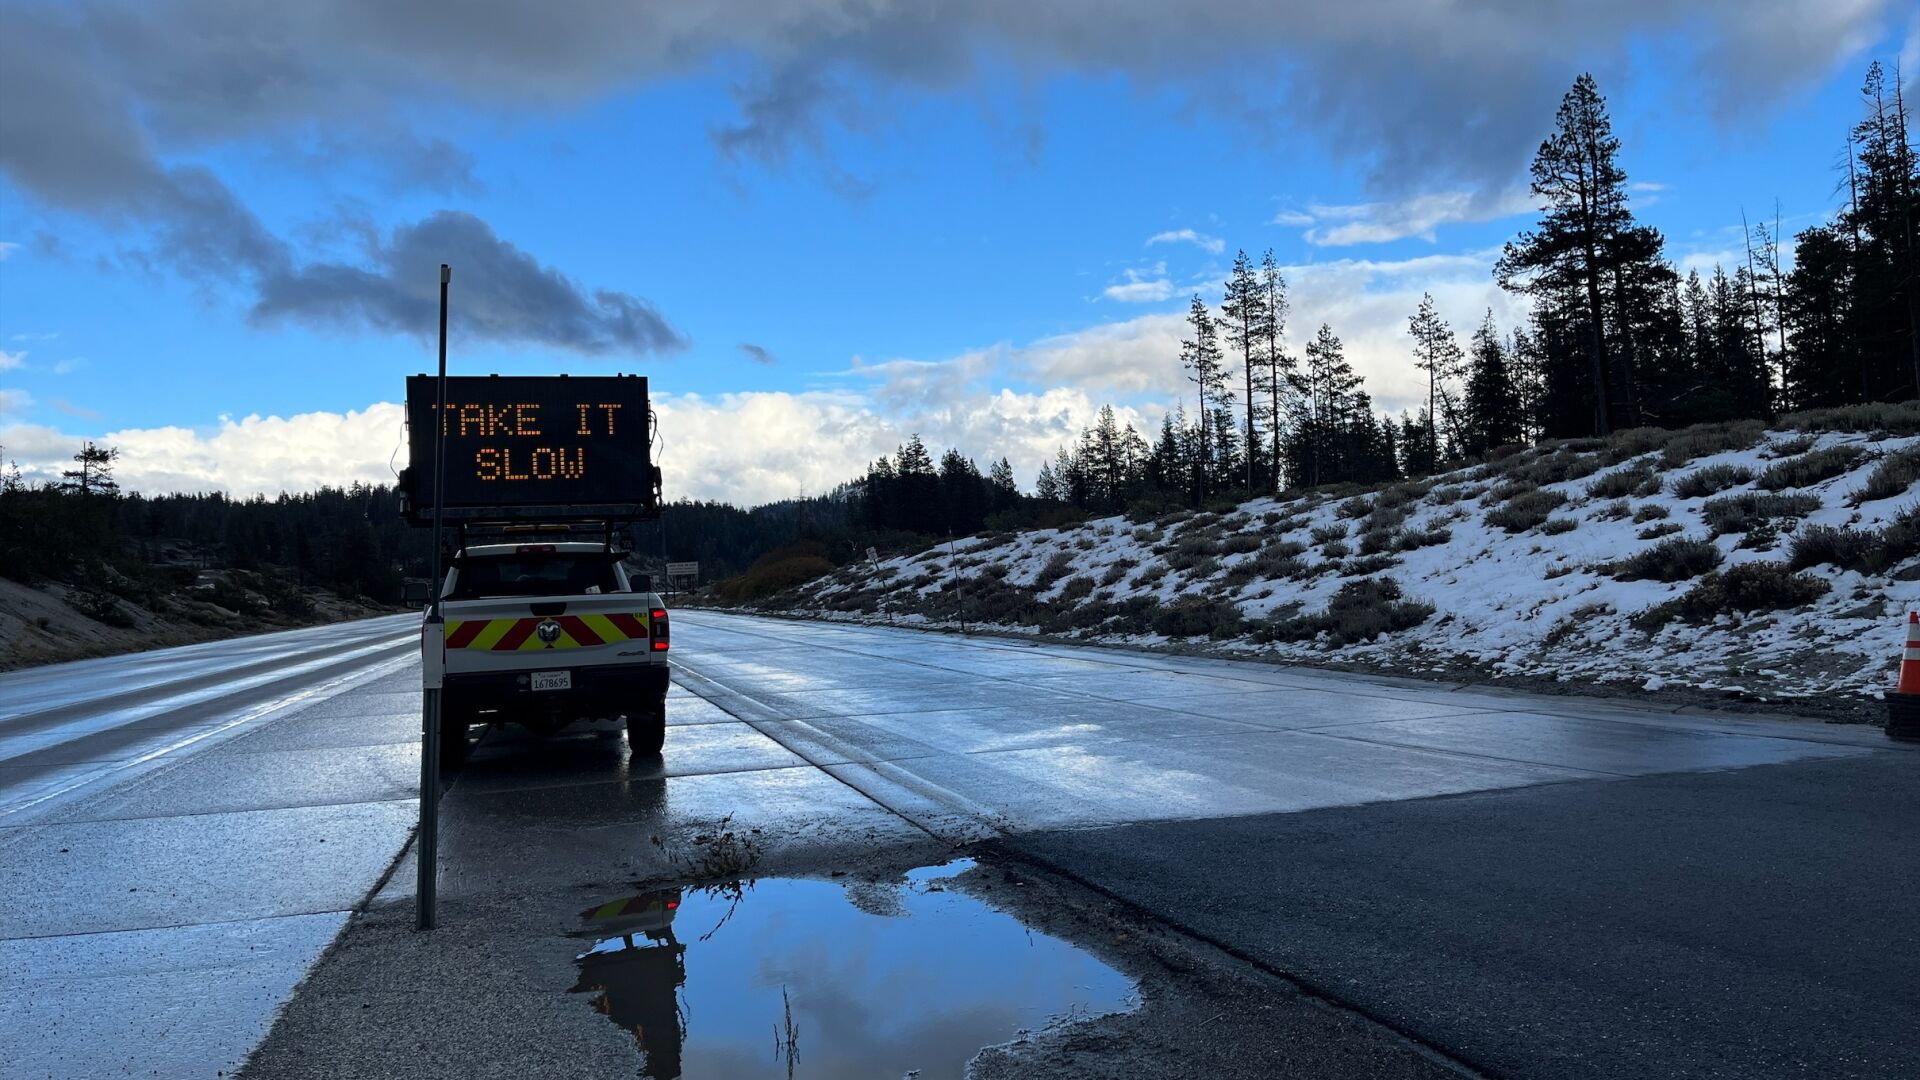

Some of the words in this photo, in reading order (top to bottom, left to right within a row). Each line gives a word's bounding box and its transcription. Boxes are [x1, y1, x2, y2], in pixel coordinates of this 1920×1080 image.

[431, 403, 542, 436] TAKE
[576, 403, 624, 436] IT
[475, 447, 584, 480] SLOW
[534, 677, 569, 689] 1678695
